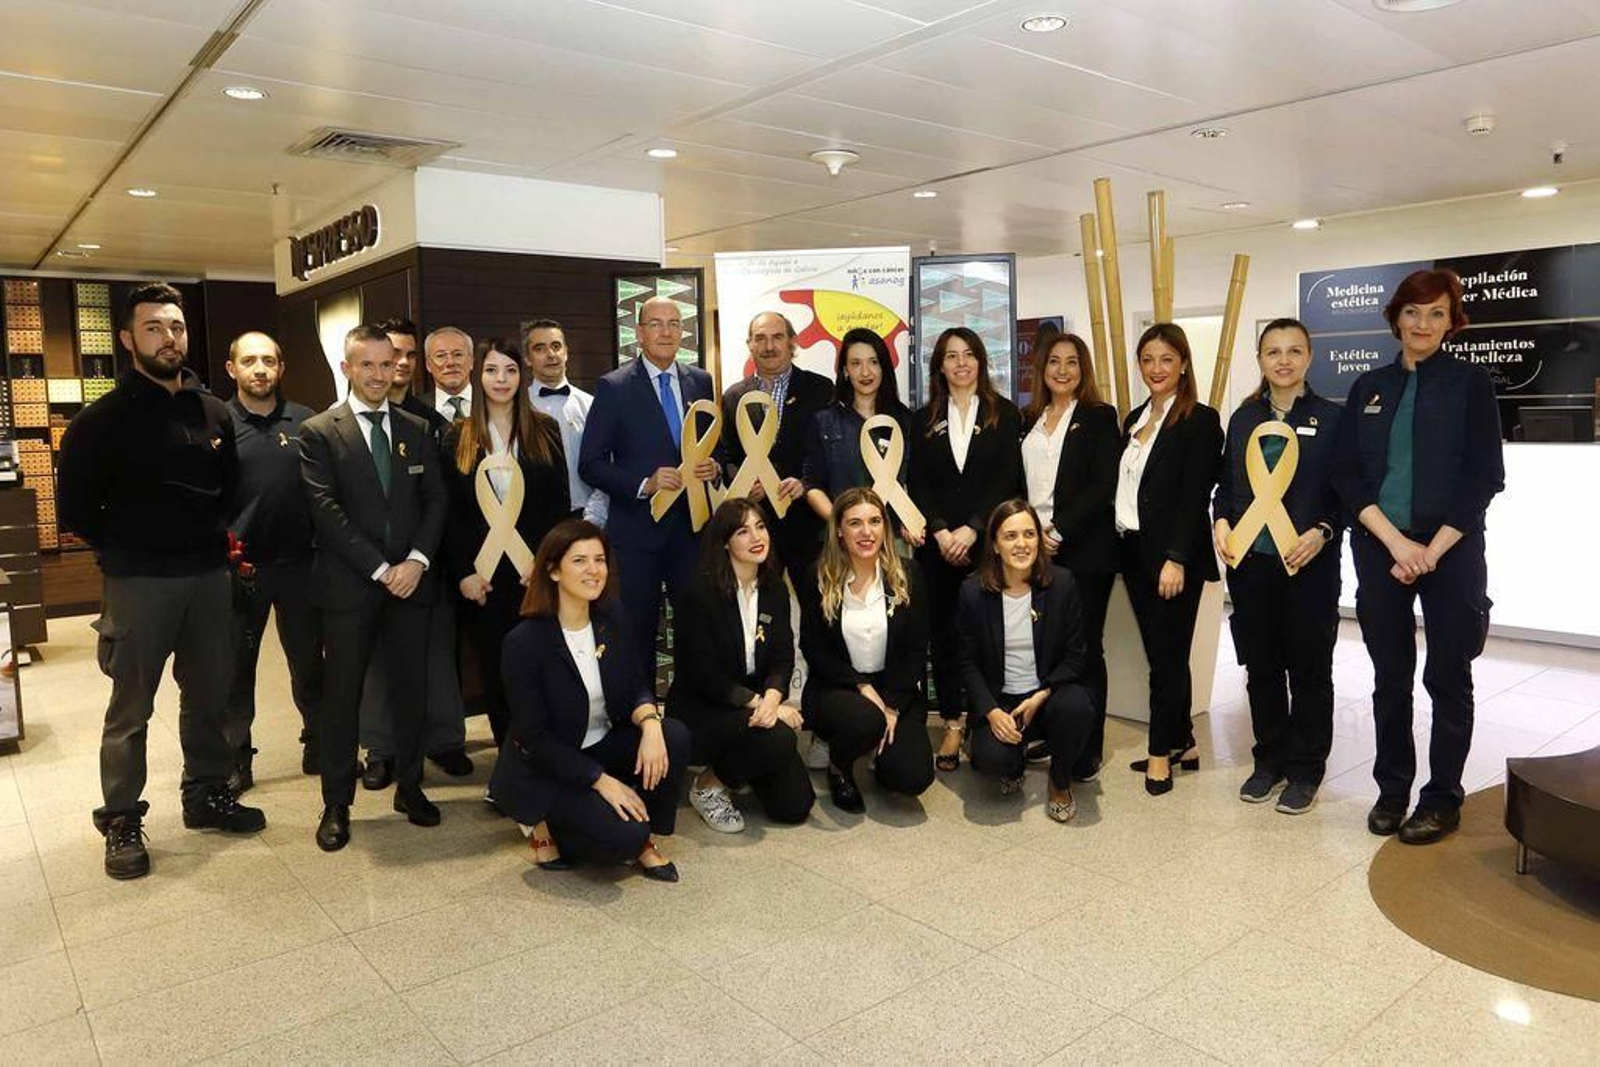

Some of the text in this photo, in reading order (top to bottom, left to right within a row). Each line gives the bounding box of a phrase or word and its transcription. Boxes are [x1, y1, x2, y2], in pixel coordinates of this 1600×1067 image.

[1455, 269, 1528, 289] epilación
[1326, 283, 1385, 298] Medicina
[1481, 286, 1538, 301] Médica
[1331, 296, 1379, 309] estética
[1330, 349, 1379, 362] Estética
[1470, 351, 1523, 364] belleza
[1337, 361, 1371, 375] joven
